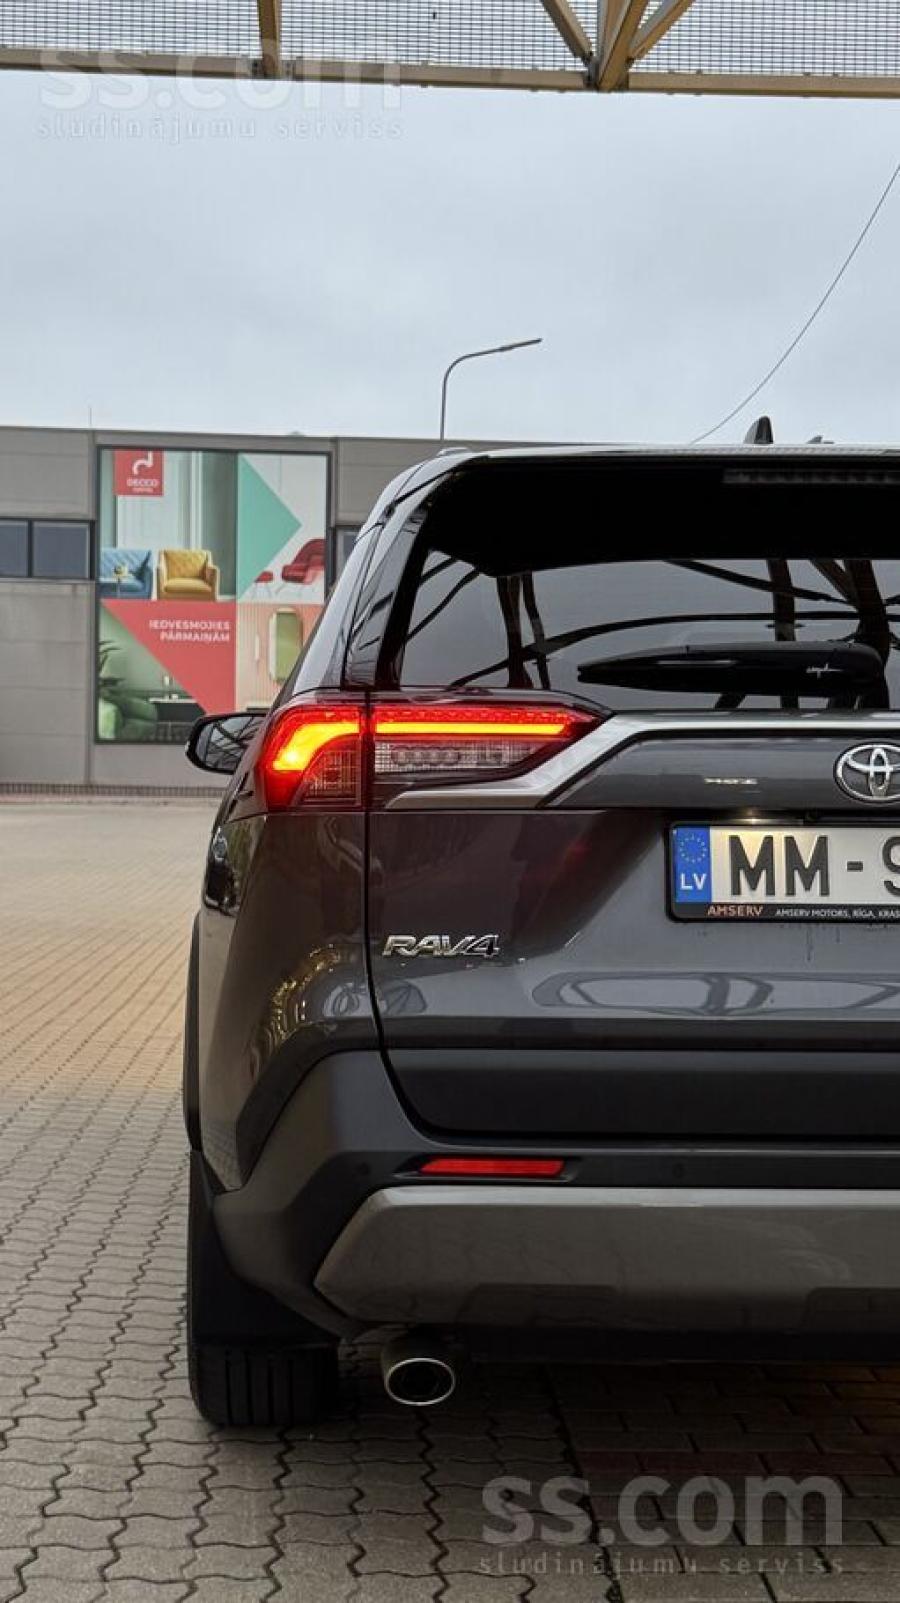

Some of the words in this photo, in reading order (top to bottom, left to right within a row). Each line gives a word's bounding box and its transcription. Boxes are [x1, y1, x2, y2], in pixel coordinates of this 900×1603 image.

[680, 873, 707, 891] LV
[708, 905, 763, 917] AMSERV
[775, 908, 810, 917] AMSERV
[382, 934, 500, 958] RAV4
